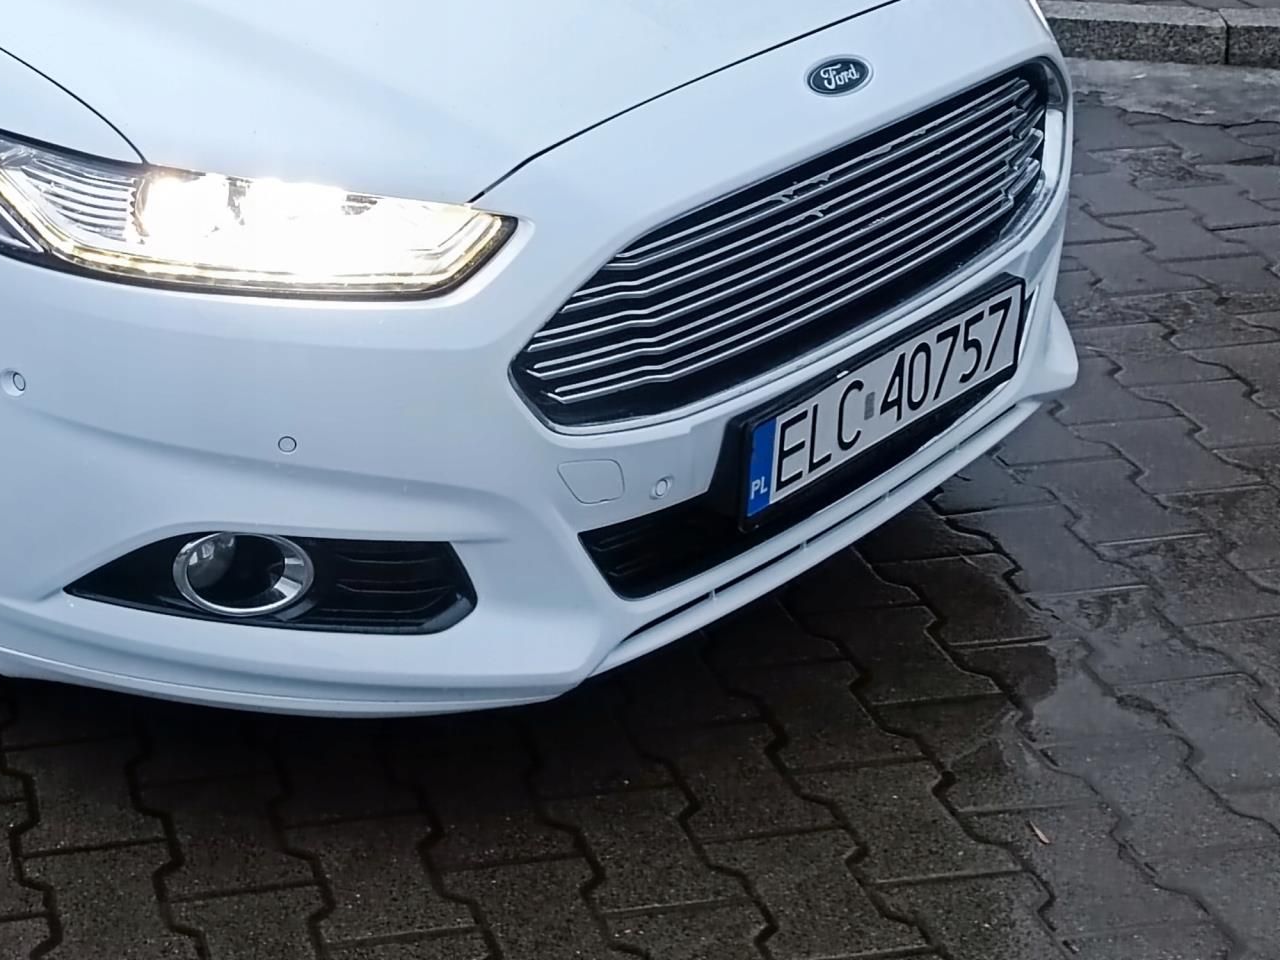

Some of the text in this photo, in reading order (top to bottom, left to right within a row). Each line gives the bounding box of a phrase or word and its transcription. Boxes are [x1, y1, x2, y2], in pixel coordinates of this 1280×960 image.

[820, 63, 860, 90] Ford
[776, 296, 1012, 492] ELC 40757
[751, 476, 768, 500] PL
